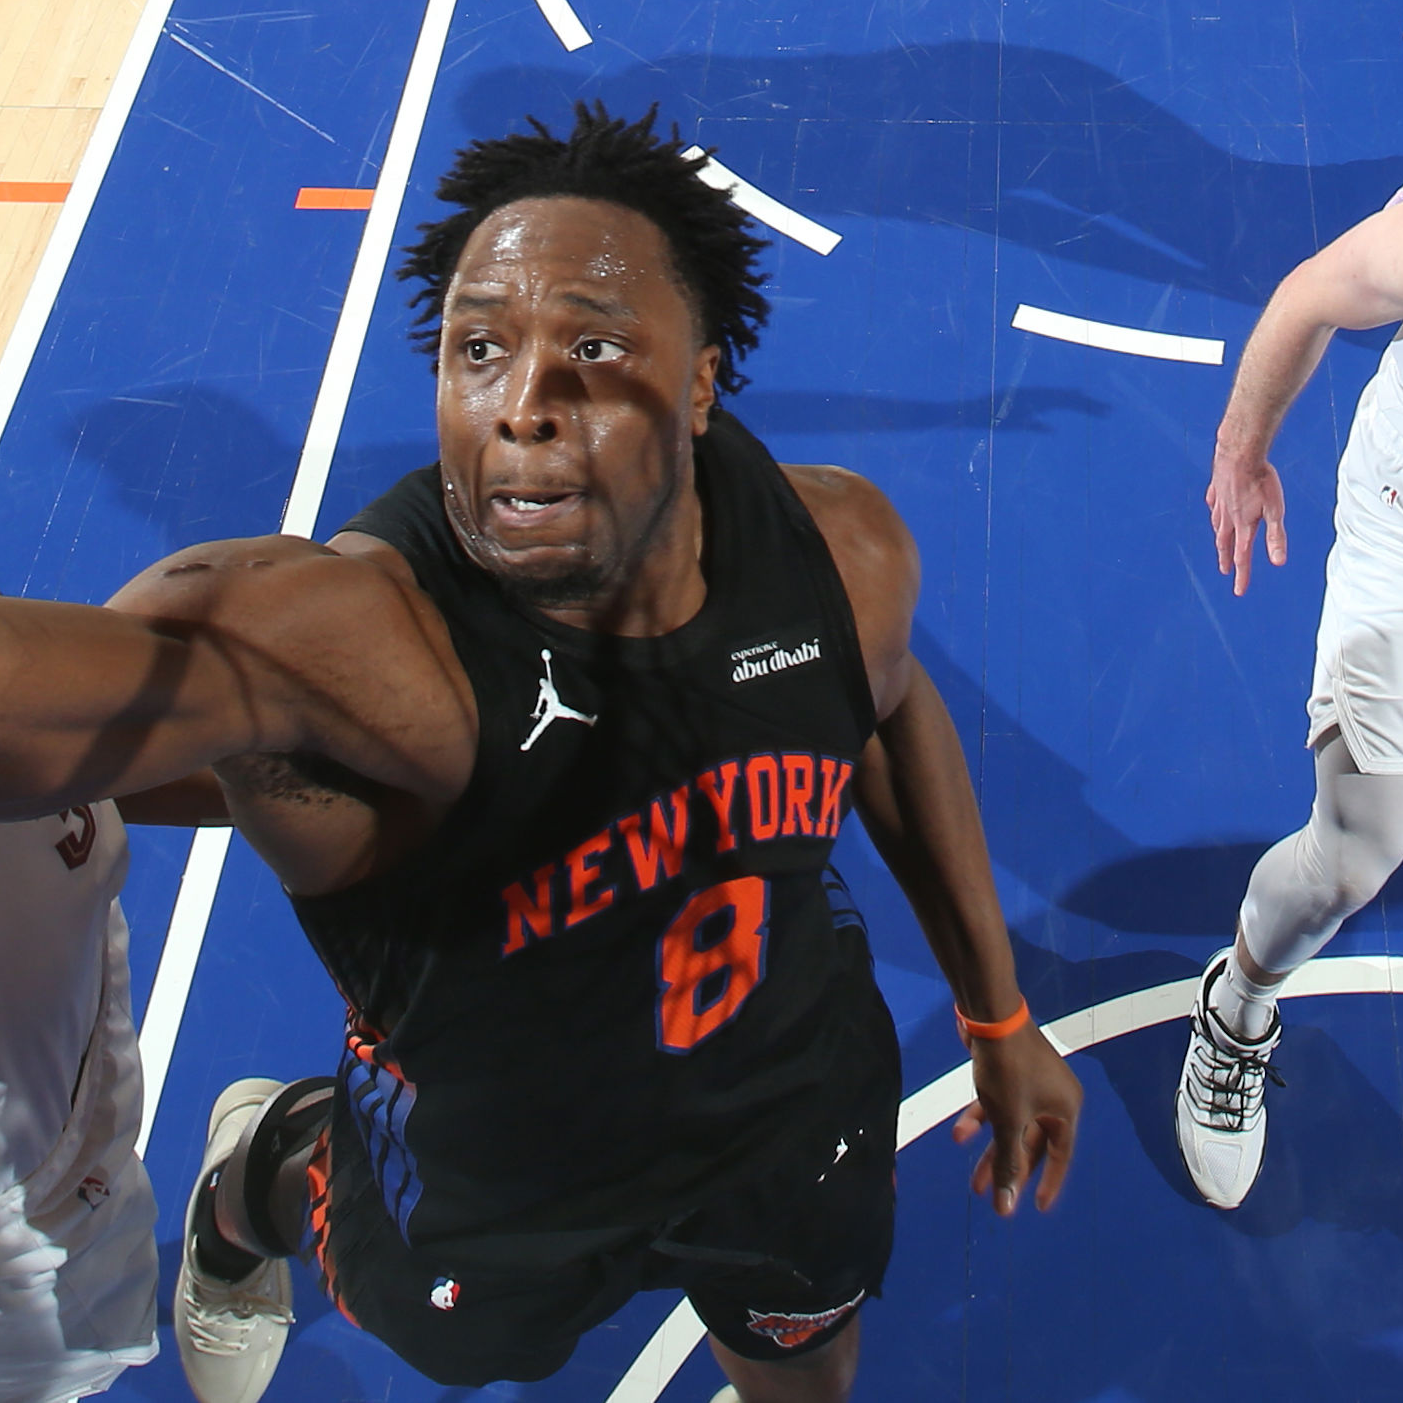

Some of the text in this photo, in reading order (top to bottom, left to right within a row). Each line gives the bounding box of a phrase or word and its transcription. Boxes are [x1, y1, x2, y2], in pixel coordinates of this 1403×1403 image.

[732, 638, 821, 683] abu dhabi
[501, 751, 854, 958] NEW YORK
[655, 874, 772, 1056] 8
